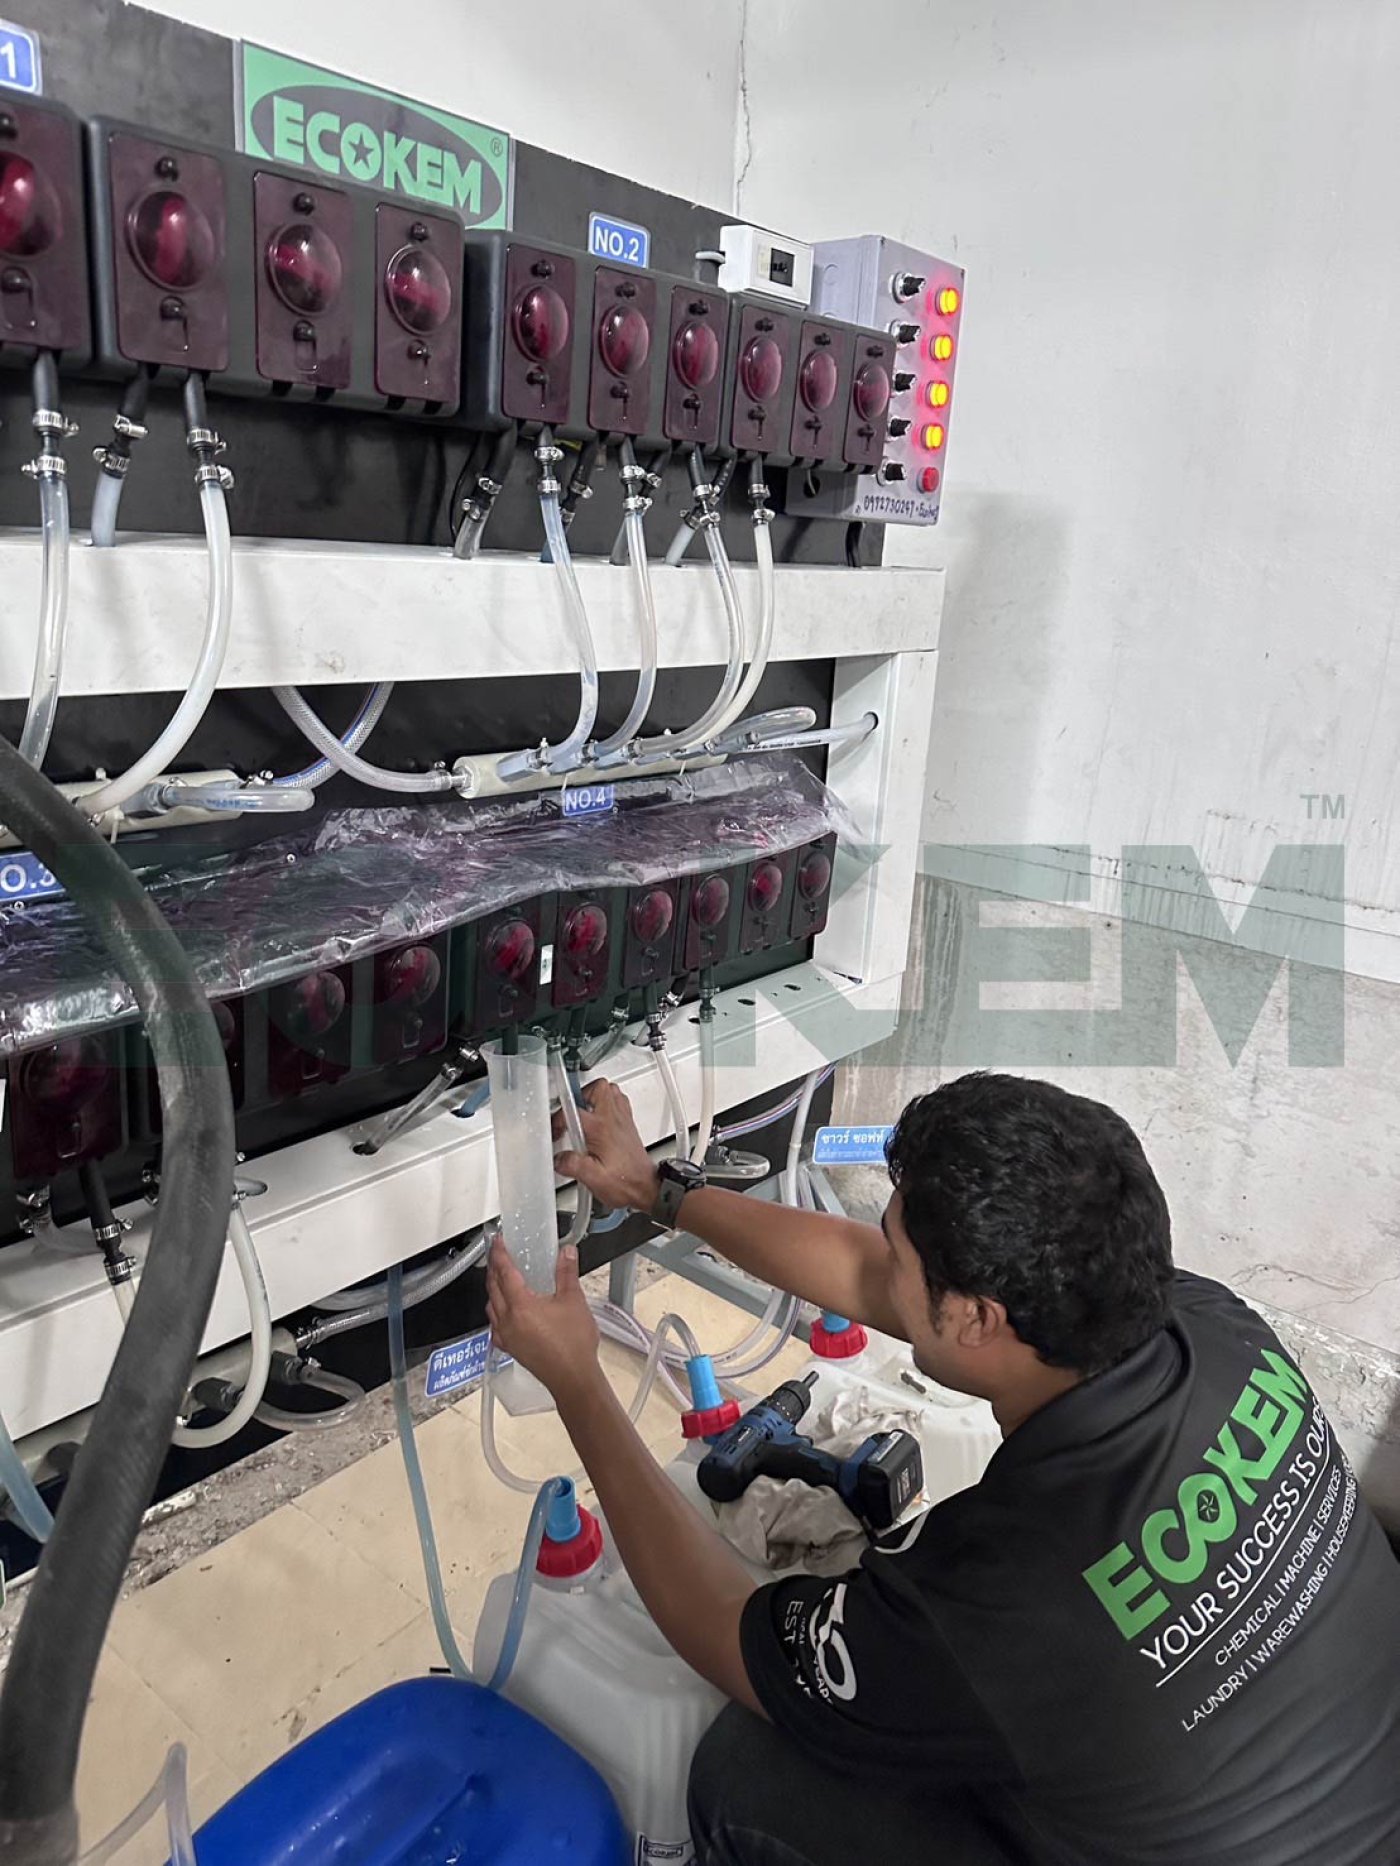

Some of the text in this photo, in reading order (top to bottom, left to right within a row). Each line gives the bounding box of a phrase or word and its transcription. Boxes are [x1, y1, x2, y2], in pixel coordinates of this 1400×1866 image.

[273, 95, 482, 215] ECOKEM
[595, 225, 640, 262] NO.2
[565, 786, 606, 811] NO.4
[1082, 1349, 1308, 1641] ECOKEM
[1139, 1592, 1224, 1669] YOUR
[1216, 1480, 1301, 1600] SUCCESS
[1288, 1452, 1317, 1489] IS
[1215, 1594, 1282, 1666] CHEMICAL
[1279, 1524, 1322, 1591] MACHINE
[1317, 1464, 1342, 1525] SERVICES
[1182, 1665, 1249, 1732] LAUNDRY
[1250, 1563, 1329, 1664] WAREWASHING
